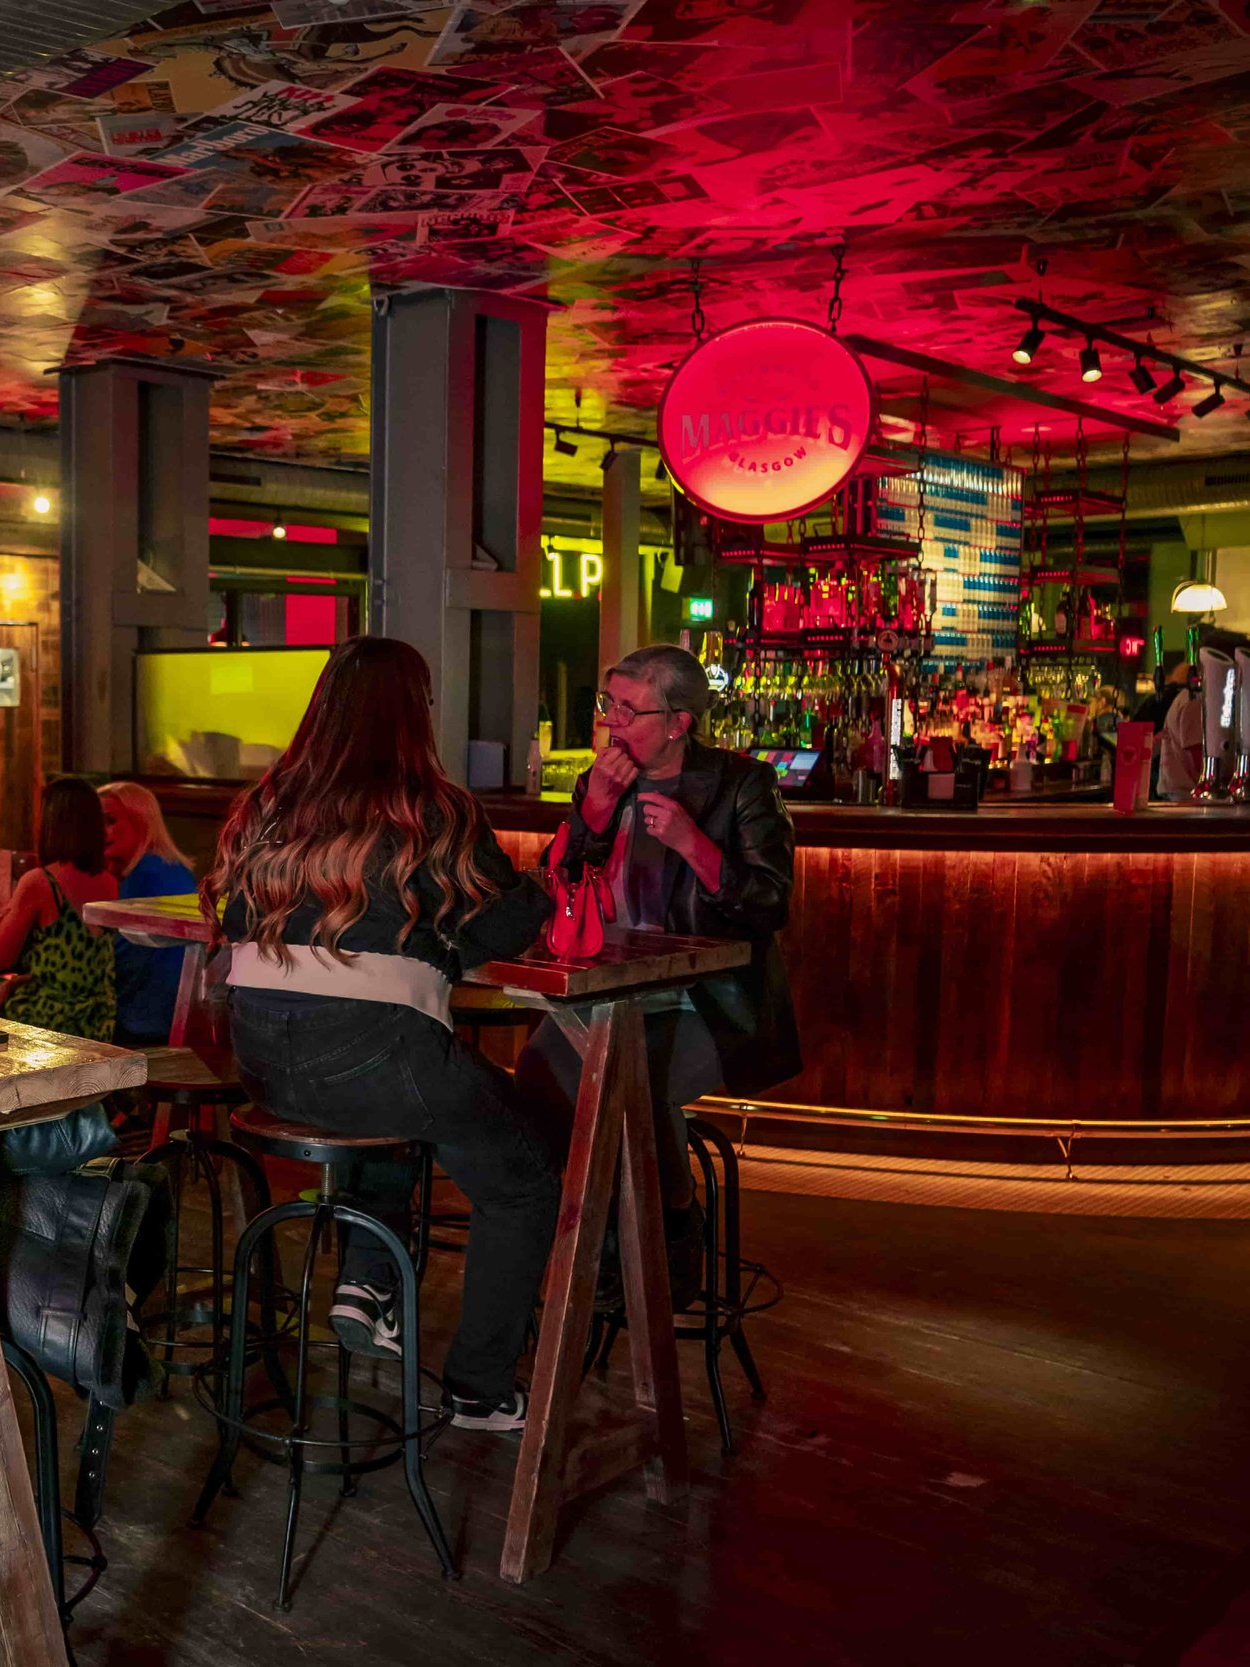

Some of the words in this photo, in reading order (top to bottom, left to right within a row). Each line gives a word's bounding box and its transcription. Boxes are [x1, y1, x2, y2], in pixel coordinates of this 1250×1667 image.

[154, 125, 269, 166] Marlboro
[727, 445, 808, 474] GLASGOW
[540, 552, 604, 598] LP
